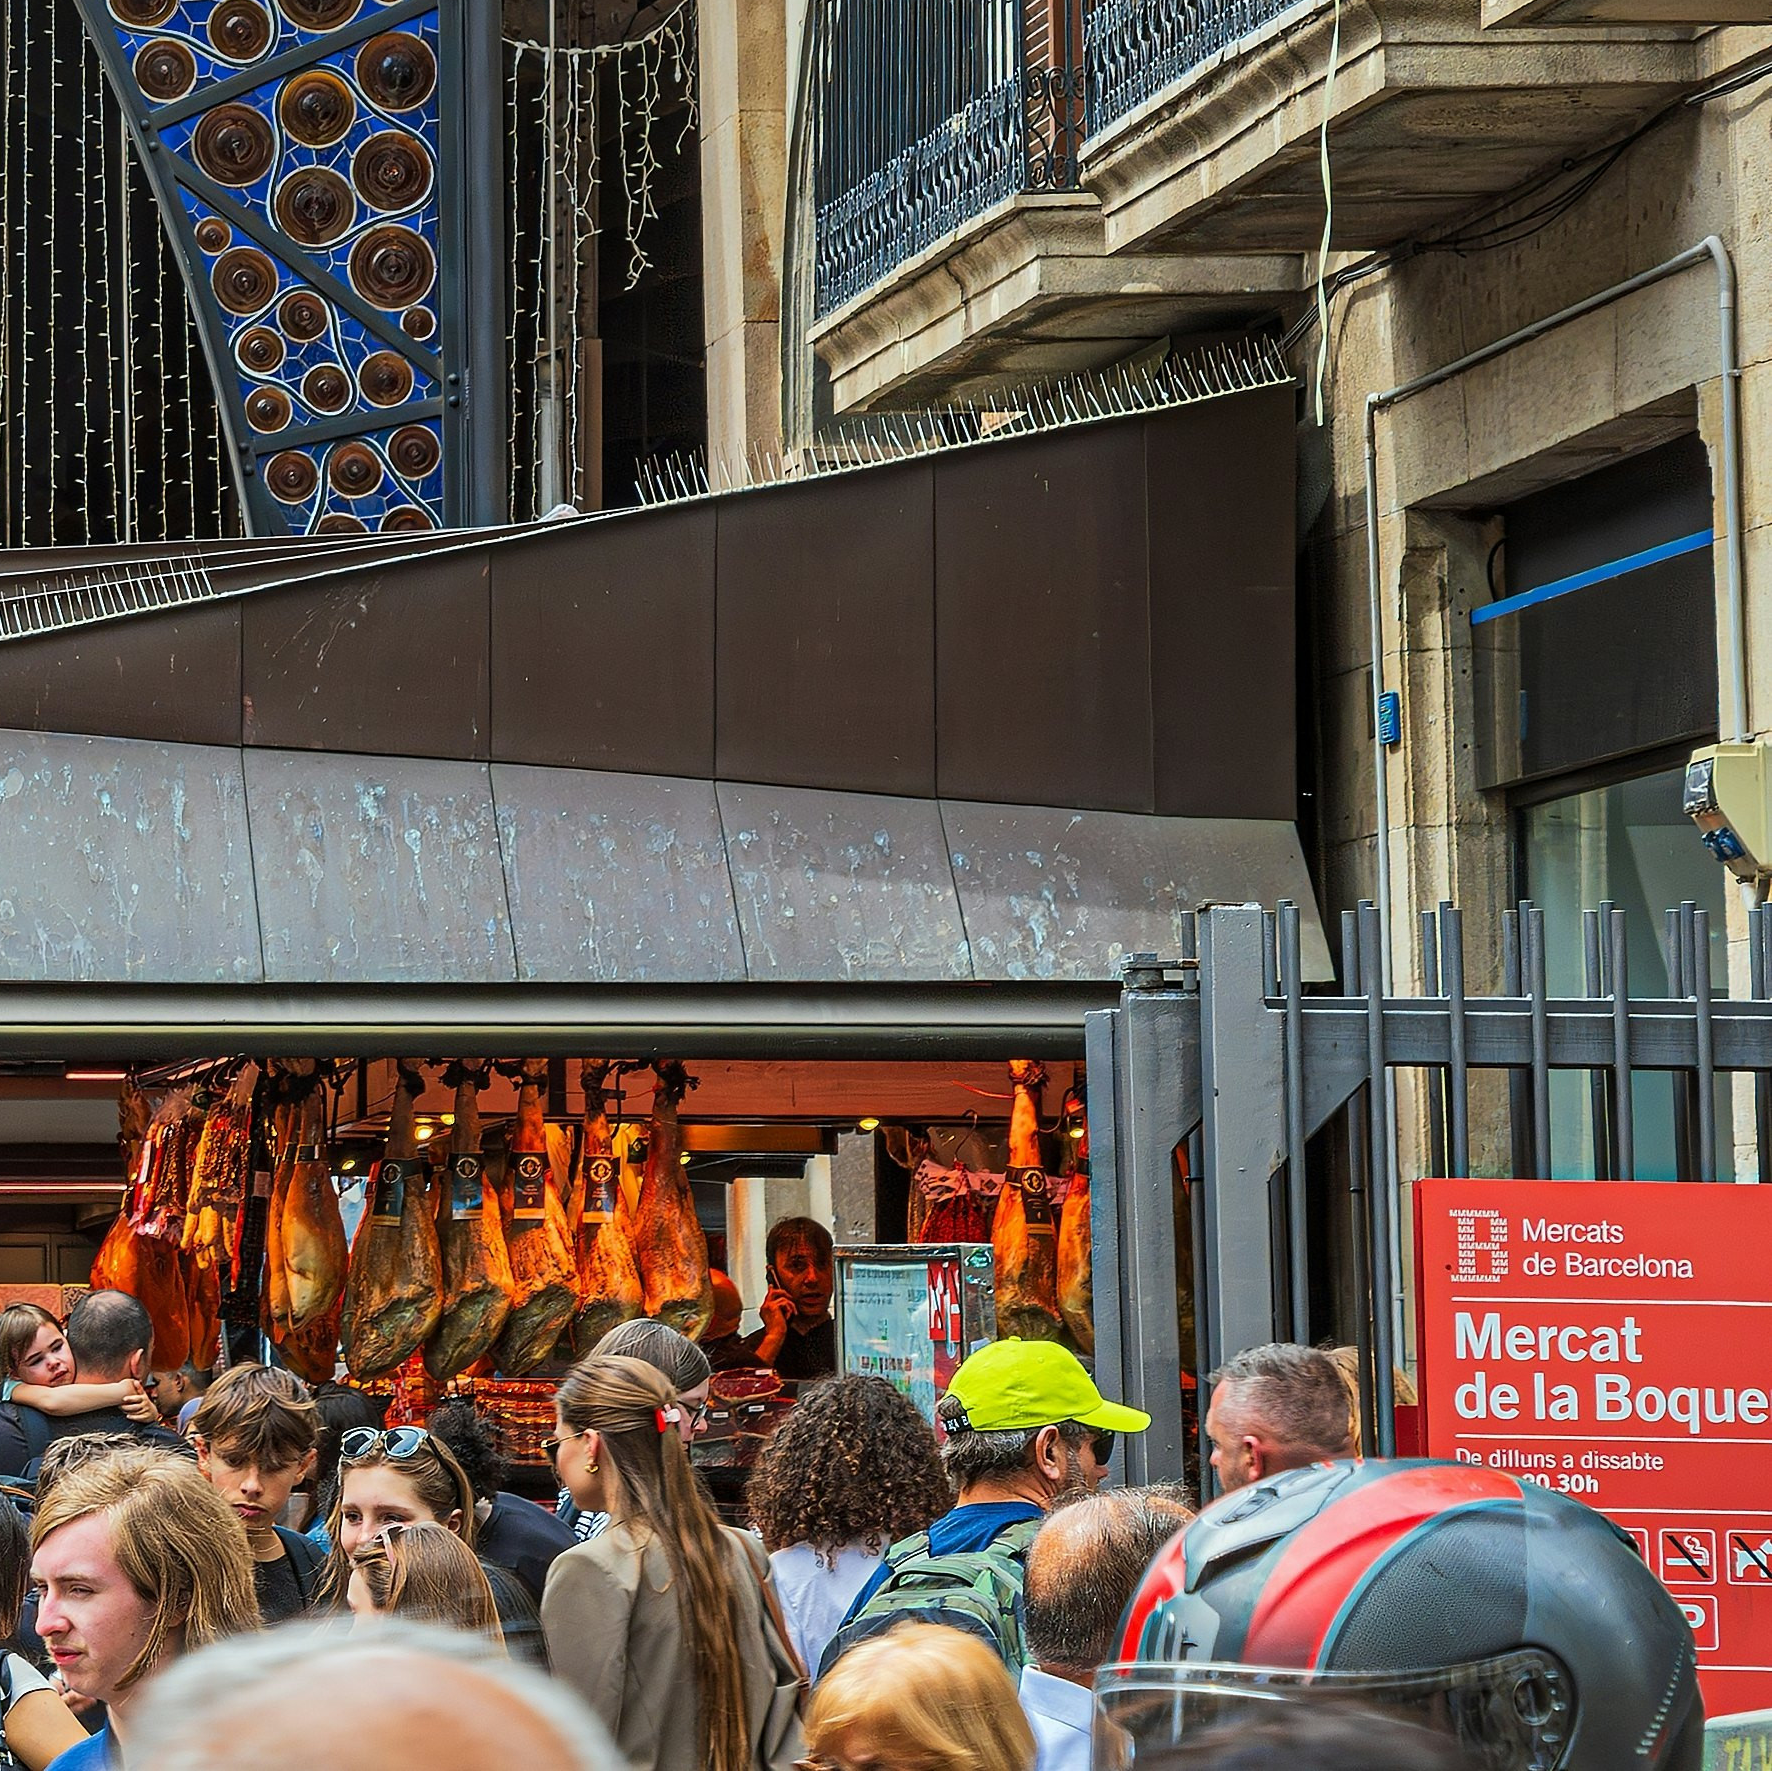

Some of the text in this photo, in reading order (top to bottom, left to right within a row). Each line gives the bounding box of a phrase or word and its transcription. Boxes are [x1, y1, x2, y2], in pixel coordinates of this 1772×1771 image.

[1522, 1218, 1625, 1245] Mercats
[1522, 1252, 1694, 1279] de Barcelona
[1454, 1311, 1643, 1364] Mercat
[1454, 1371, 1772, 1435] de la Boque
[1455, 1447, 1664, 1472] De dilluns a dissabte
